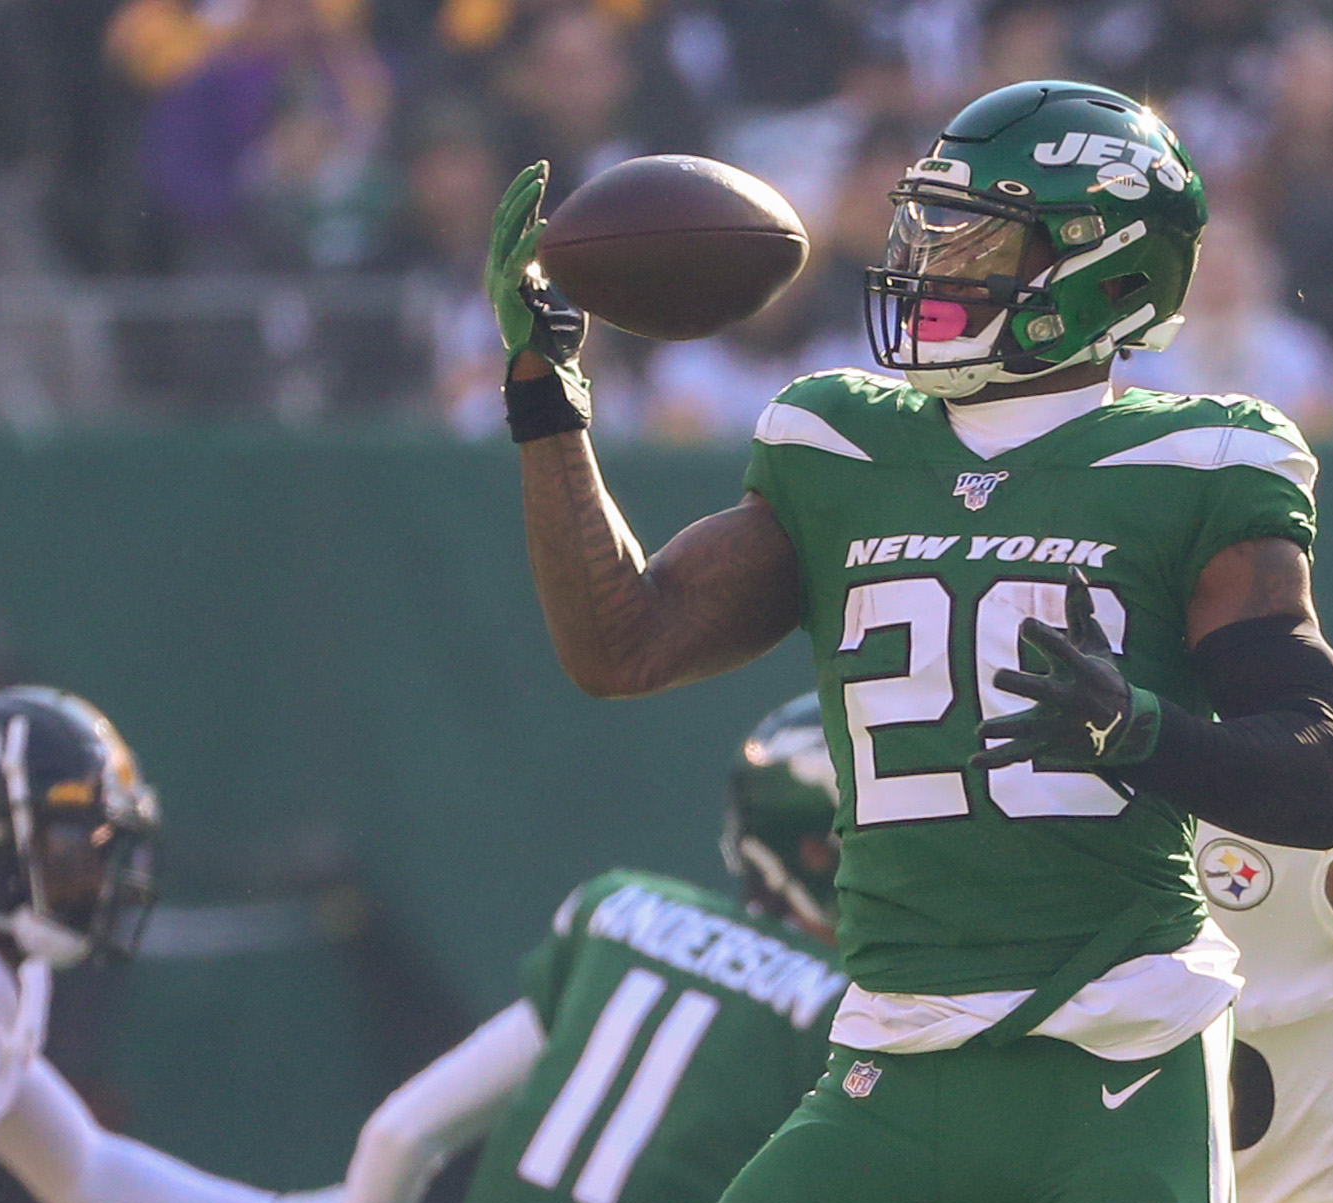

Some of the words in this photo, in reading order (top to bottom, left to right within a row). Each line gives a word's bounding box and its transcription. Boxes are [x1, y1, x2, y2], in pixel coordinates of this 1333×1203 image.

[1032, 131, 1187, 193] JETS
[844, 534, 961, 569] NEW
[965, 535, 1117, 569] YORK
[586, 884, 851, 1031] ANDERSON
